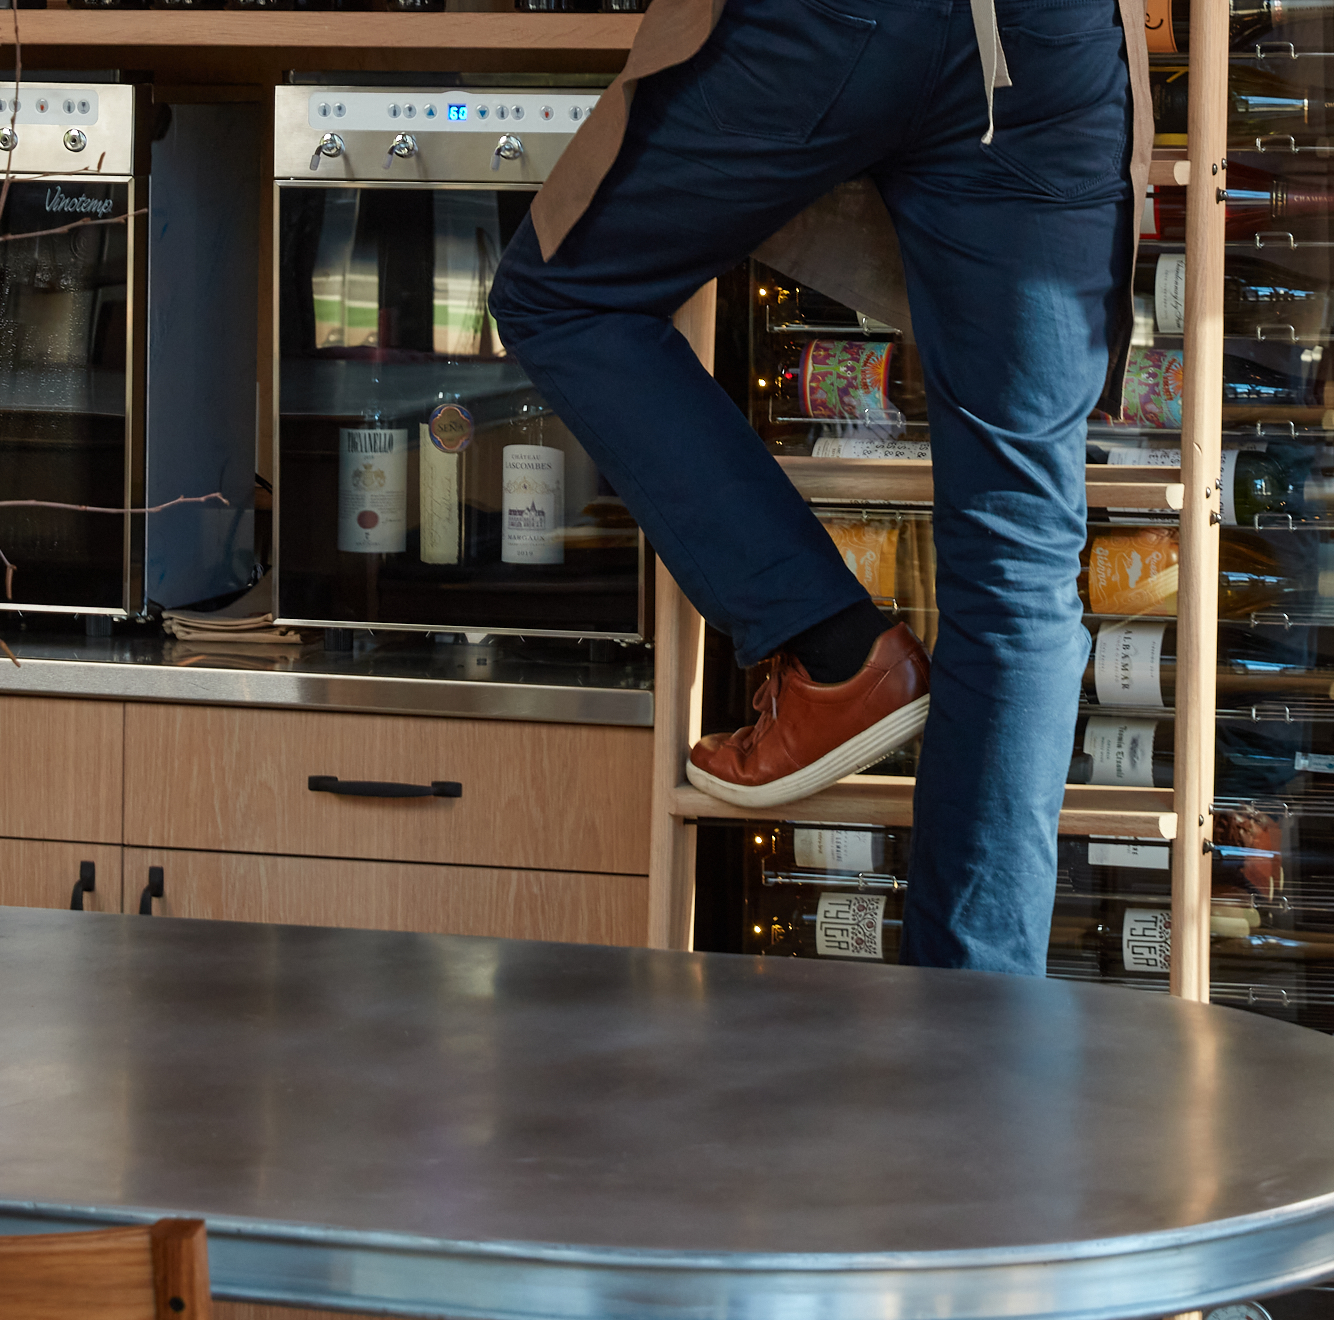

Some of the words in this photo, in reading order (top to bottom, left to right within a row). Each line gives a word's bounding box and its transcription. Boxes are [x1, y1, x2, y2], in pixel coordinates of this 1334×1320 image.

[45, 185, 113, 218] Vinotemp
[505, 461, 553, 470] LASCOMBES
[507, 534, 545, 542] MARGAUX
[1121, 629, 1133, 690] ALBAMAR
